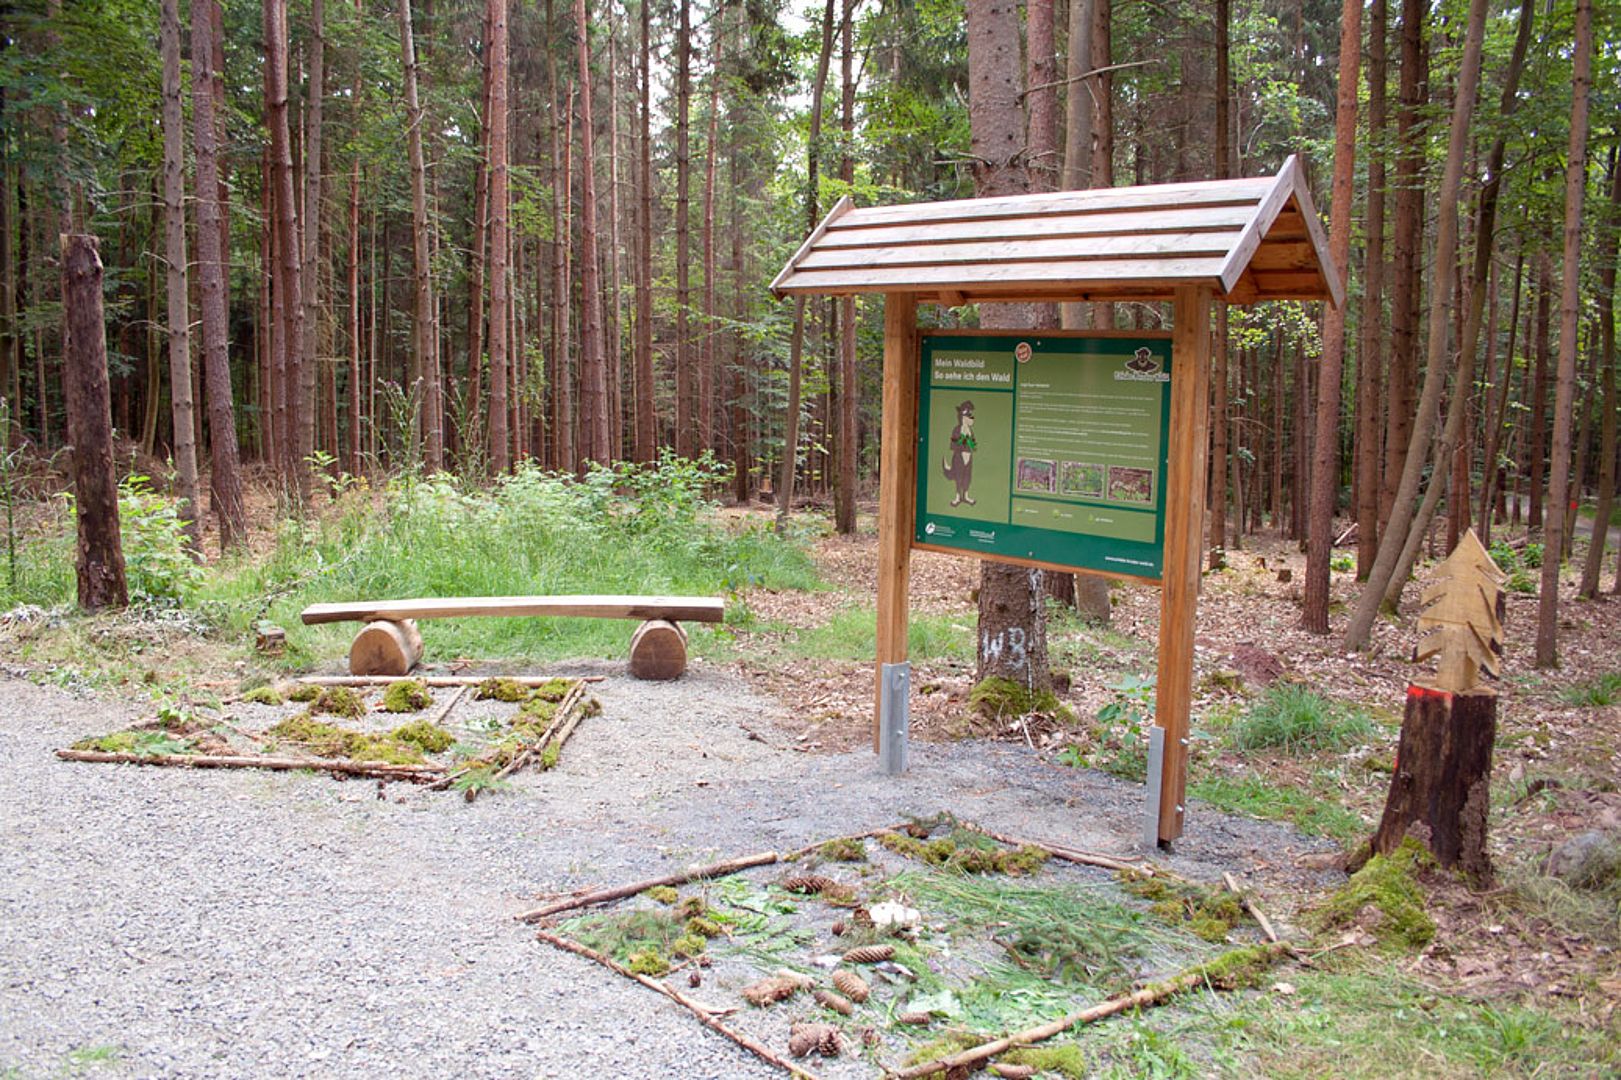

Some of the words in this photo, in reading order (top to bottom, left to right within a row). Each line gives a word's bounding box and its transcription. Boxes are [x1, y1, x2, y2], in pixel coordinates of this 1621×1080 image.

[935, 359, 952, 367] Mein
[953, 360, 985, 368] Waldbild
[934, 371, 944, 380] So
[945, 372, 961, 380] sehe
[963, 372, 974, 381] ich
[976, 373, 990, 381] den
[991, 373, 1010, 382] Wald
